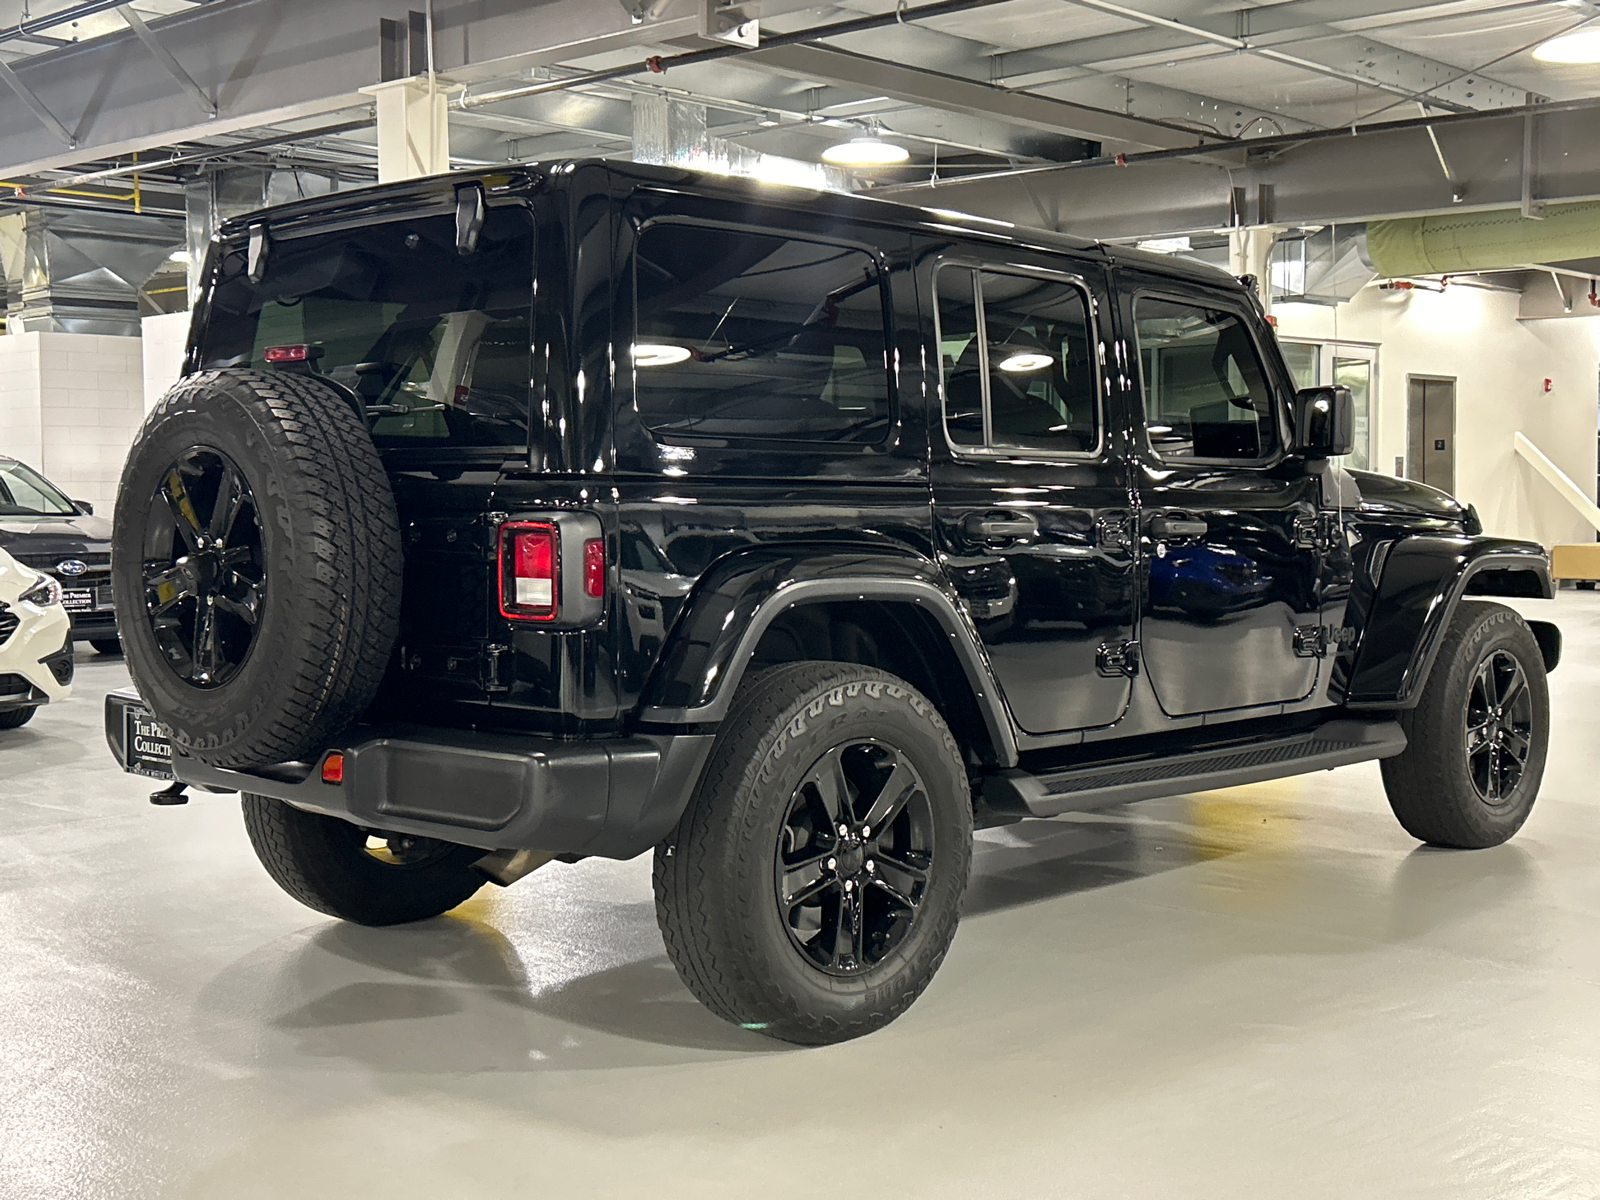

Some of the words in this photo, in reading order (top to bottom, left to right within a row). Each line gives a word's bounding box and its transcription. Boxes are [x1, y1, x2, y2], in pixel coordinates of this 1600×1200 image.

[1326, 624, 1356, 647] Jeep
[134, 720, 150, 736] THE
[134, 736, 172, 757] COLLECTI
